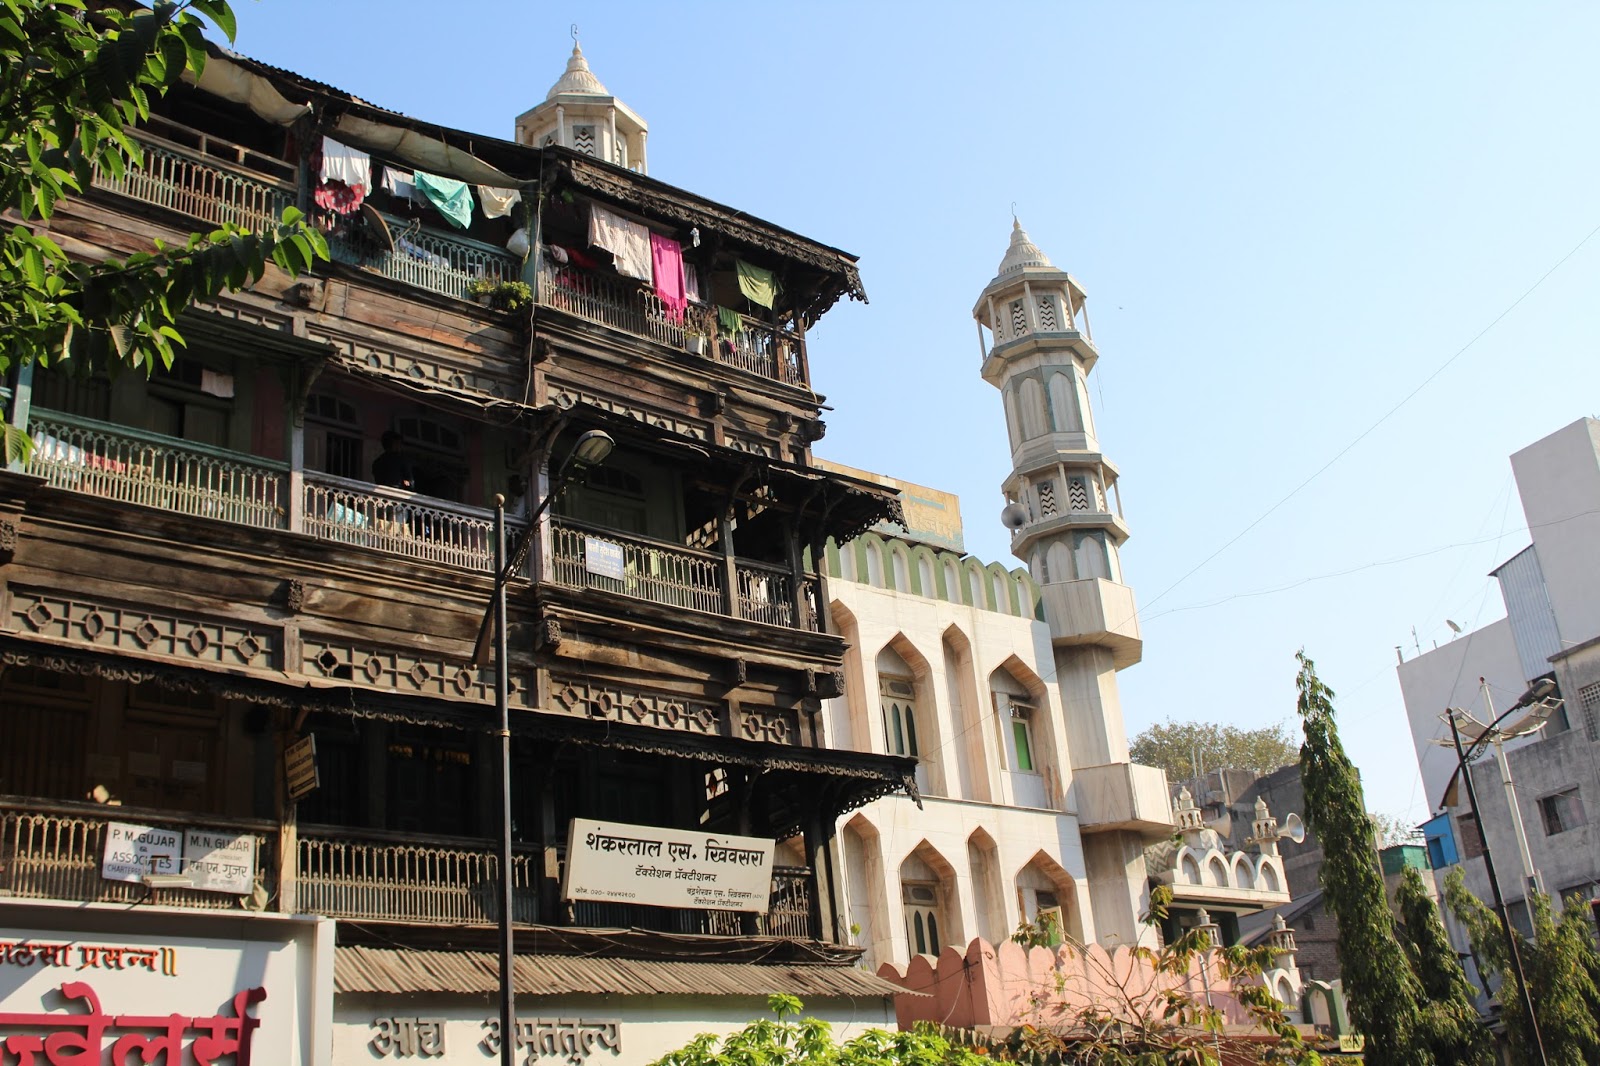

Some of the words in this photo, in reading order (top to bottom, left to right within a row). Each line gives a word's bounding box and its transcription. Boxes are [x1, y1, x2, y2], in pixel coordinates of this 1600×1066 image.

[138, 833, 176, 848] GUJAR
[214, 838, 250, 852] GUJAR
[586, 827, 663, 858] शंकरलाल
[668, 842, 697, 862] एस.
[705, 838, 765, 867] खिंवसरा
[111, 851, 172, 869] ASSOCIAES
[222, 863, 249, 879] गुजर
